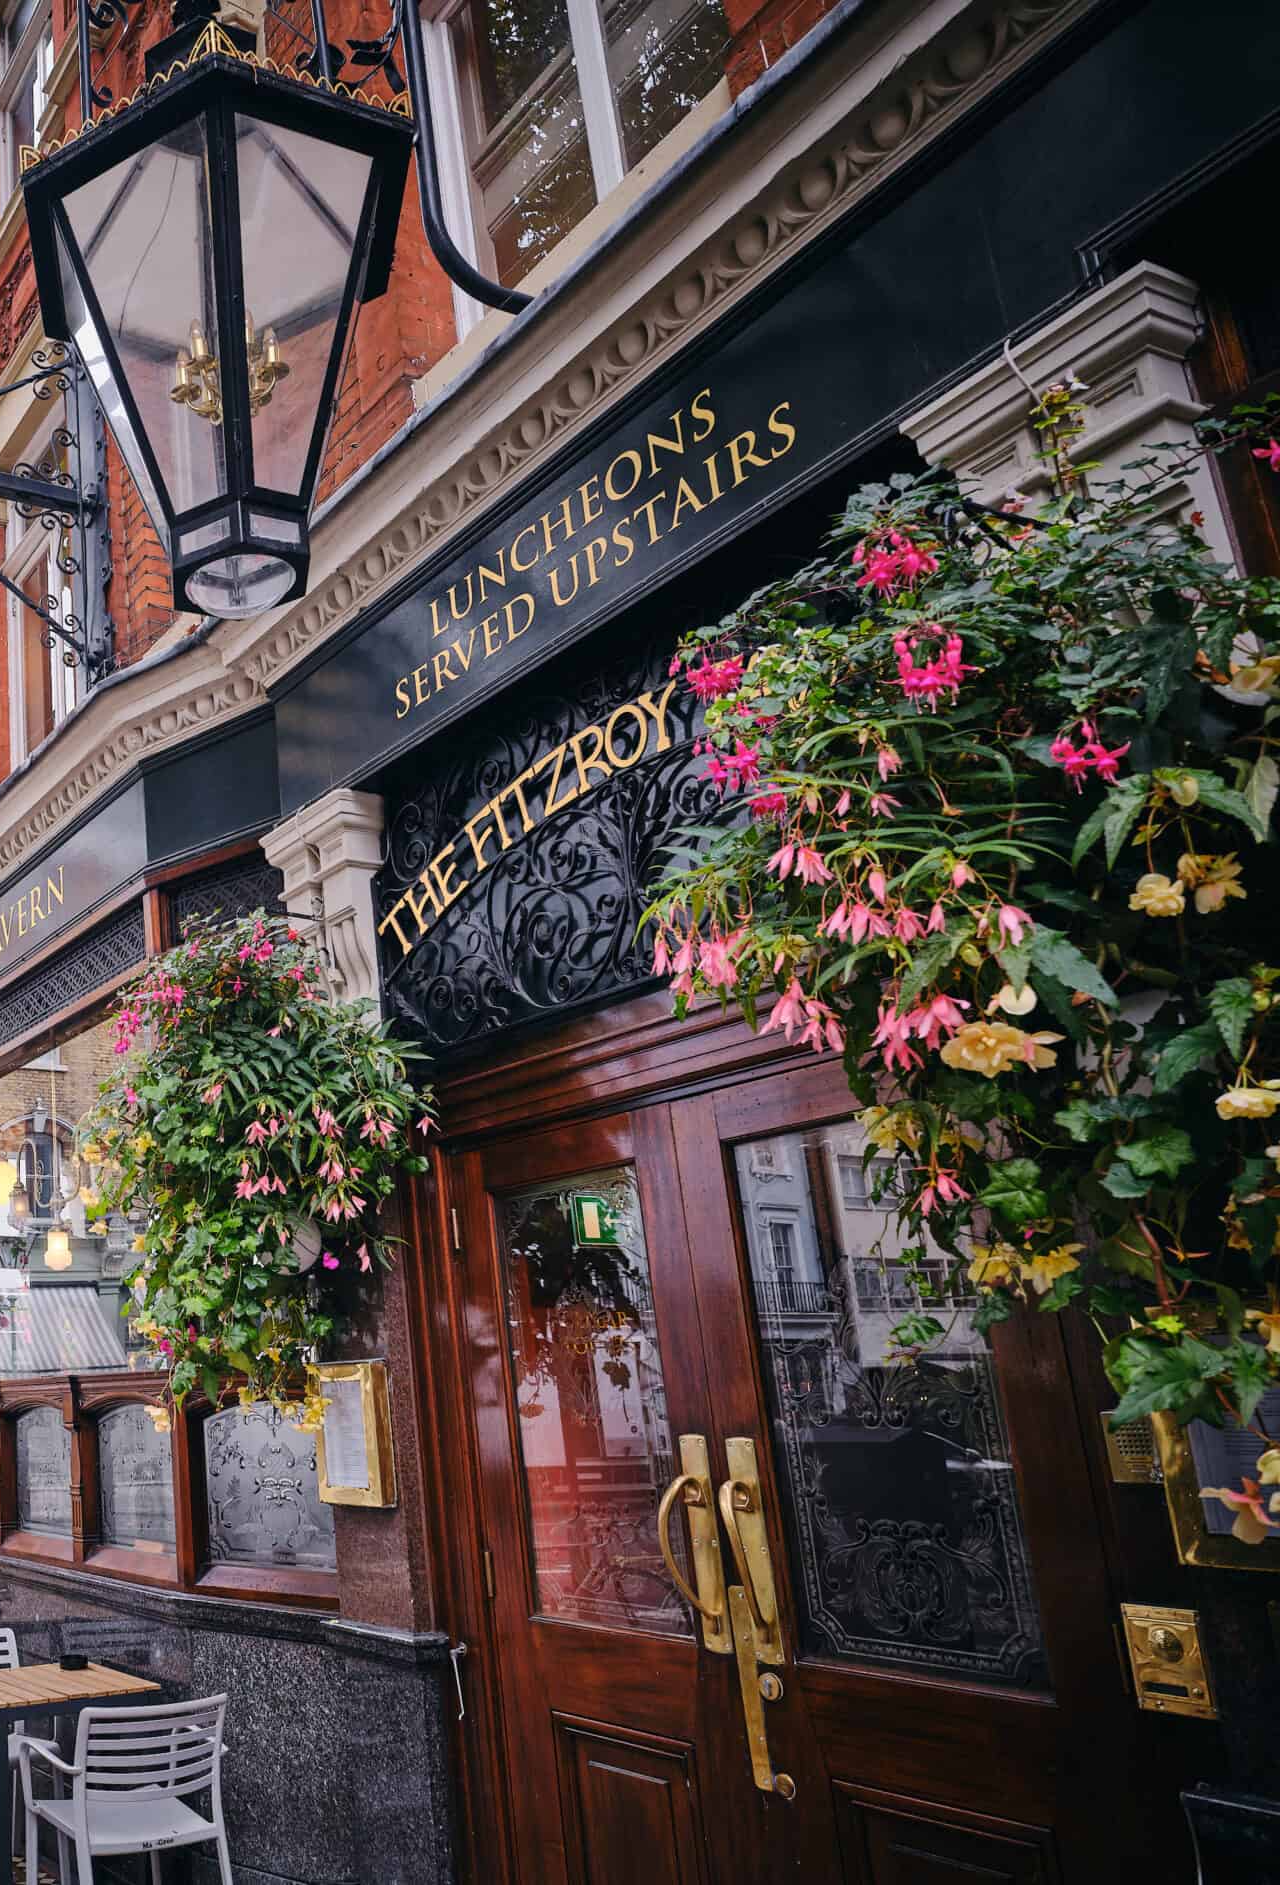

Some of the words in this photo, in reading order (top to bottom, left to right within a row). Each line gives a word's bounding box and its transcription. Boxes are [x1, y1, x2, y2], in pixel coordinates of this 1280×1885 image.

[393, 592, 536, 721] SERVED
[547, 401, 797, 606] UPSTAIRS
[428, 387, 717, 640] LUNCHEONS
[377, 843, 470, 955] THE
[464, 680, 677, 873] FITZROY
